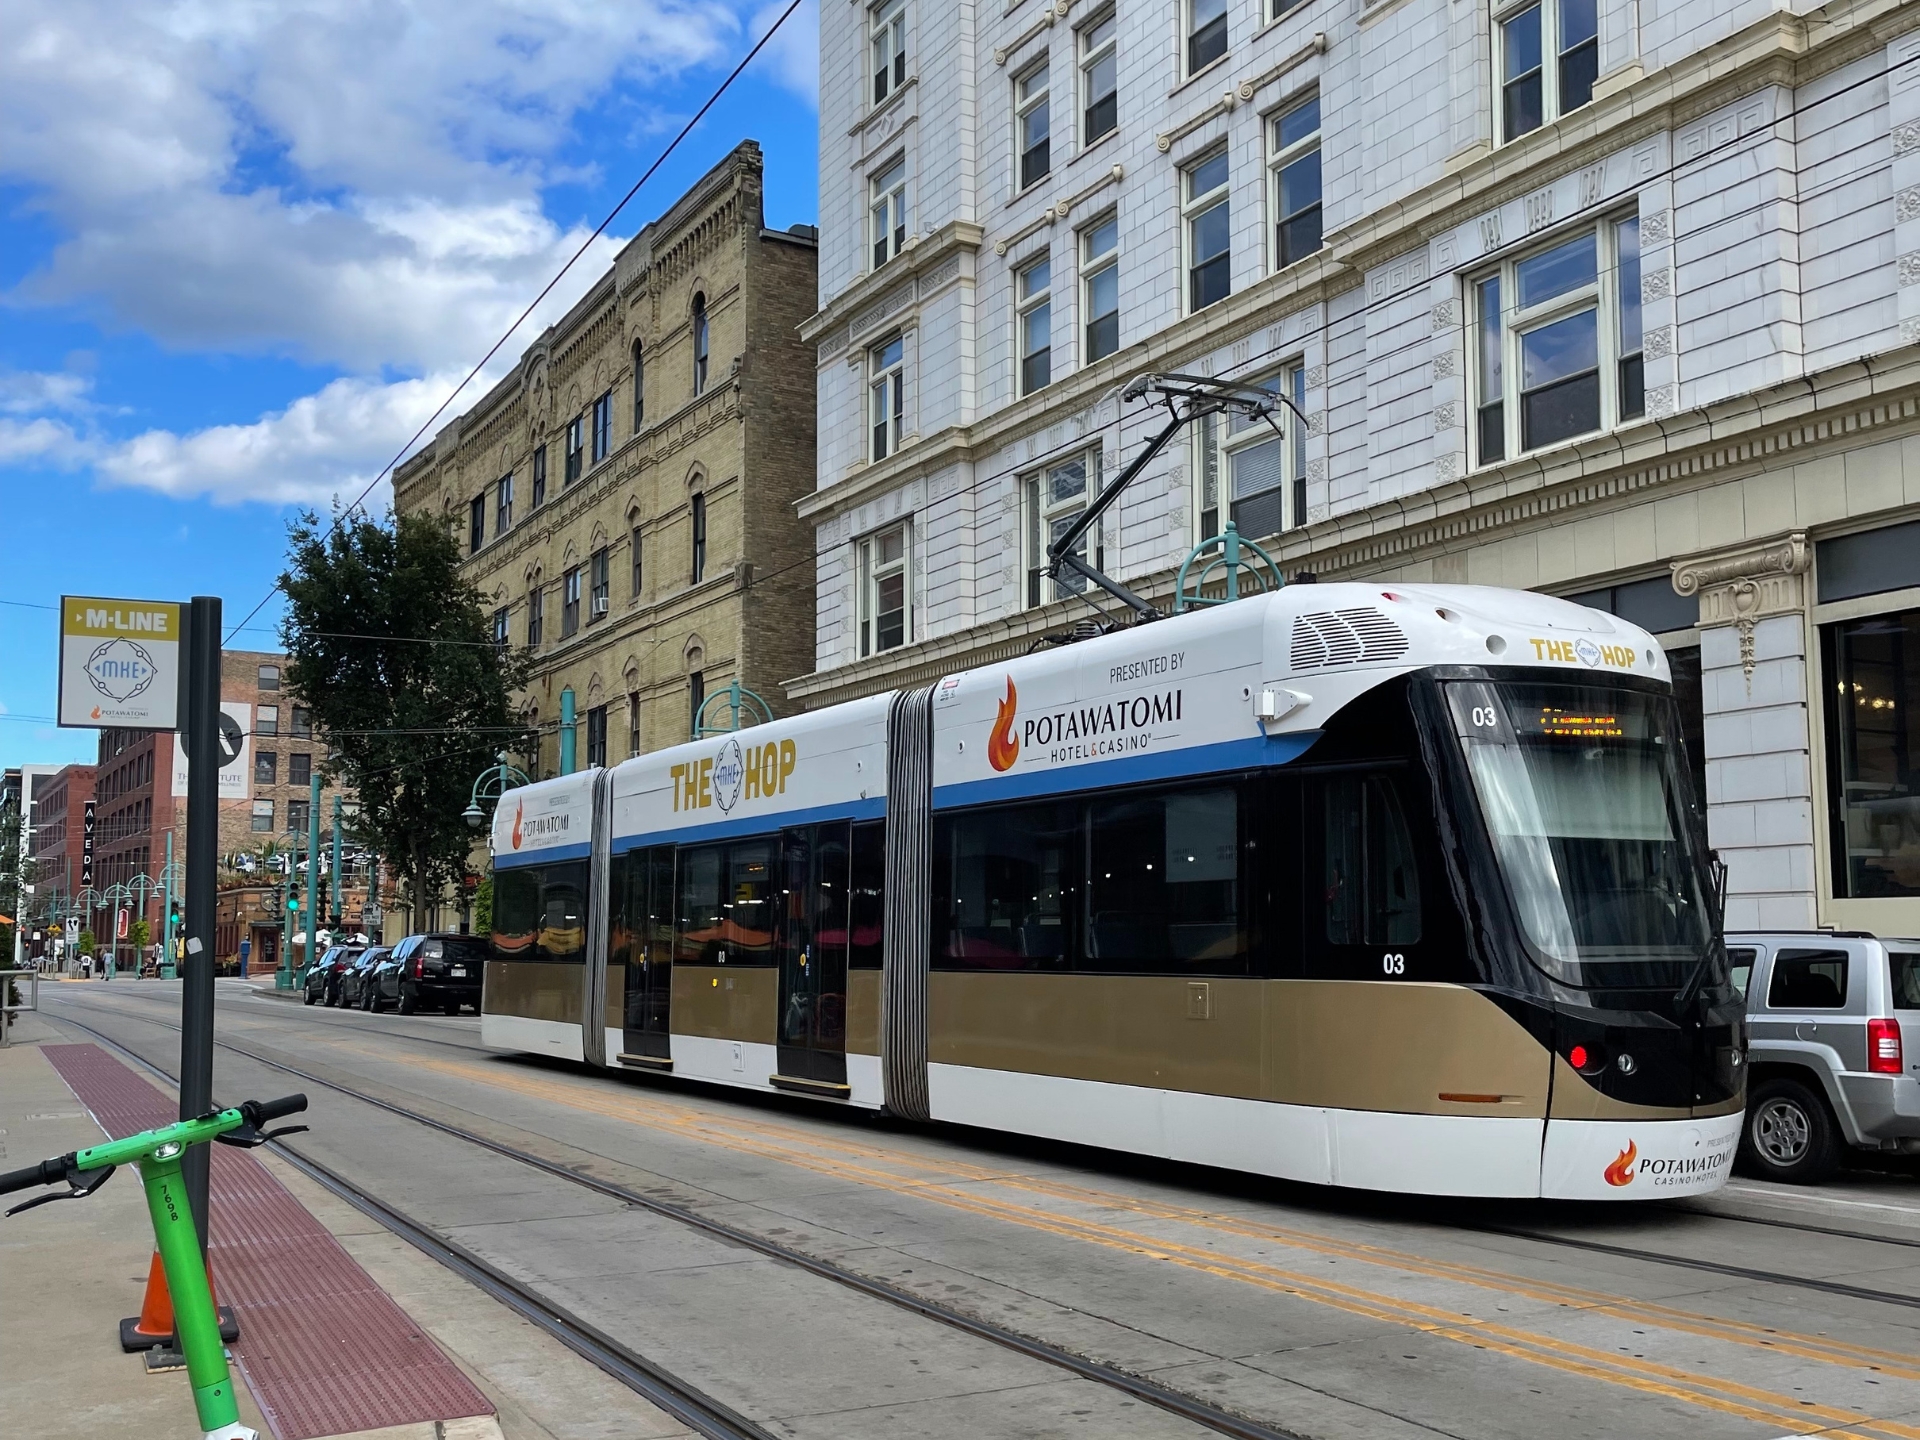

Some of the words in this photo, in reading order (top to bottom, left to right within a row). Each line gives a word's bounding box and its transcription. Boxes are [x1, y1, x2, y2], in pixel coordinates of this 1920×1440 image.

[1529, 638, 1577, 662] THE
[1599, 645, 1635, 668] HOP
[102, 660, 139, 679] MKE
[1110, 656, 1167, 684] PRESENTED
[1171, 651, 1185, 670] BY
[101, 709, 149, 717] POTAWATOMI
[1024, 689, 1182, 748] POTAWATOMI
[1472, 707, 1496, 727] 03
[670, 757, 713, 812] THE
[745, 738, 796, 800] HOP
[720, 763, 737, 785] MKE
[523, 814, 570, 837] POTAWATOMI
[83, 808, 94, 880] AVEDA
[1383, 953, 1405, 975] 03
[160, 1184, 179, 1222] 7698
